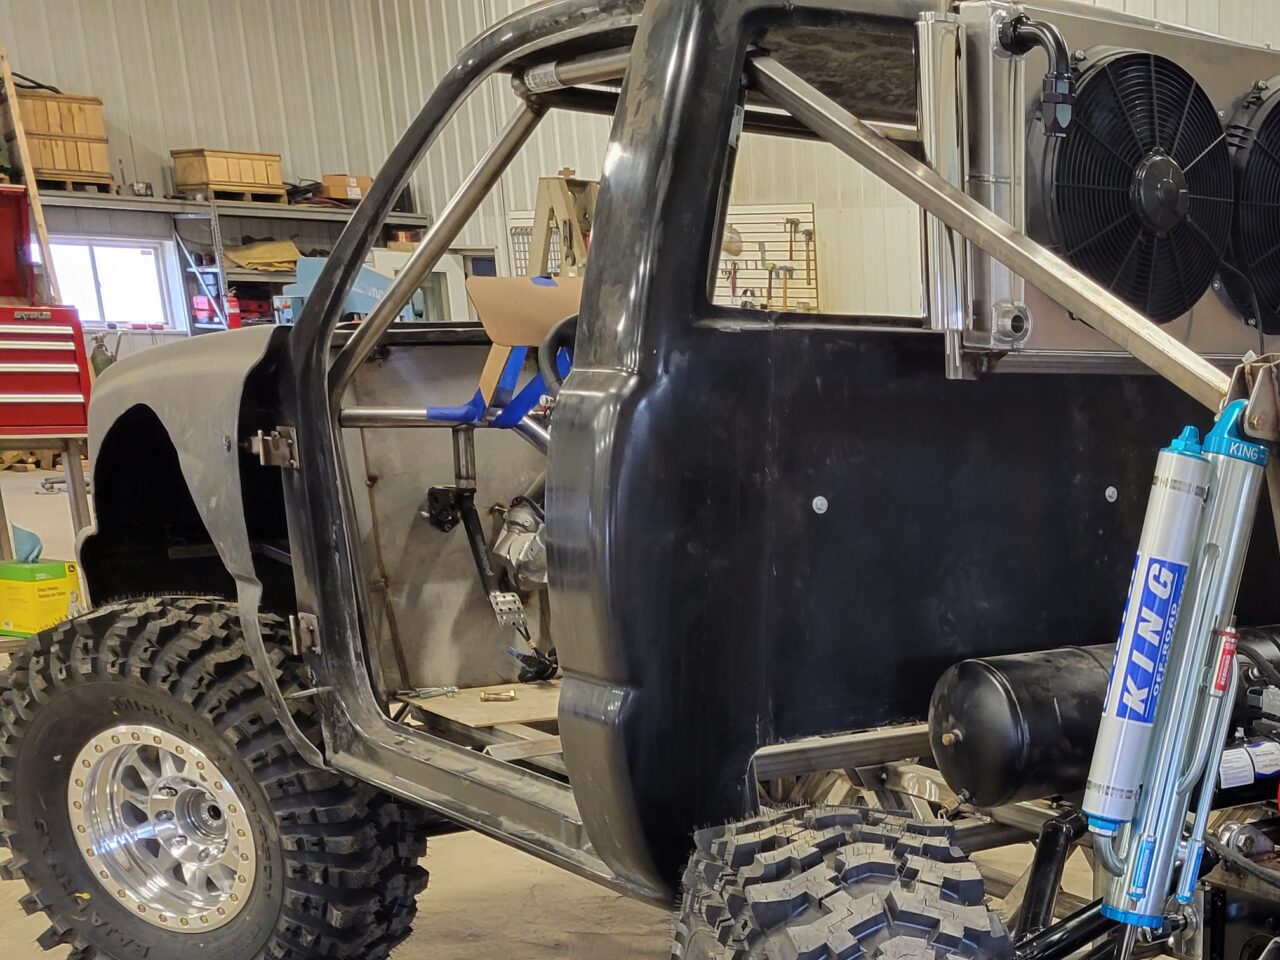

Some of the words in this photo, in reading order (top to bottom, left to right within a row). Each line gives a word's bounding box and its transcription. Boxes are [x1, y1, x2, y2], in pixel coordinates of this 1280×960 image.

[1230, 441, 1259, 460] KING
[1123, 562, 1174, 716] KING
[1153, 602, 1178, 698] OFF-ROAD
